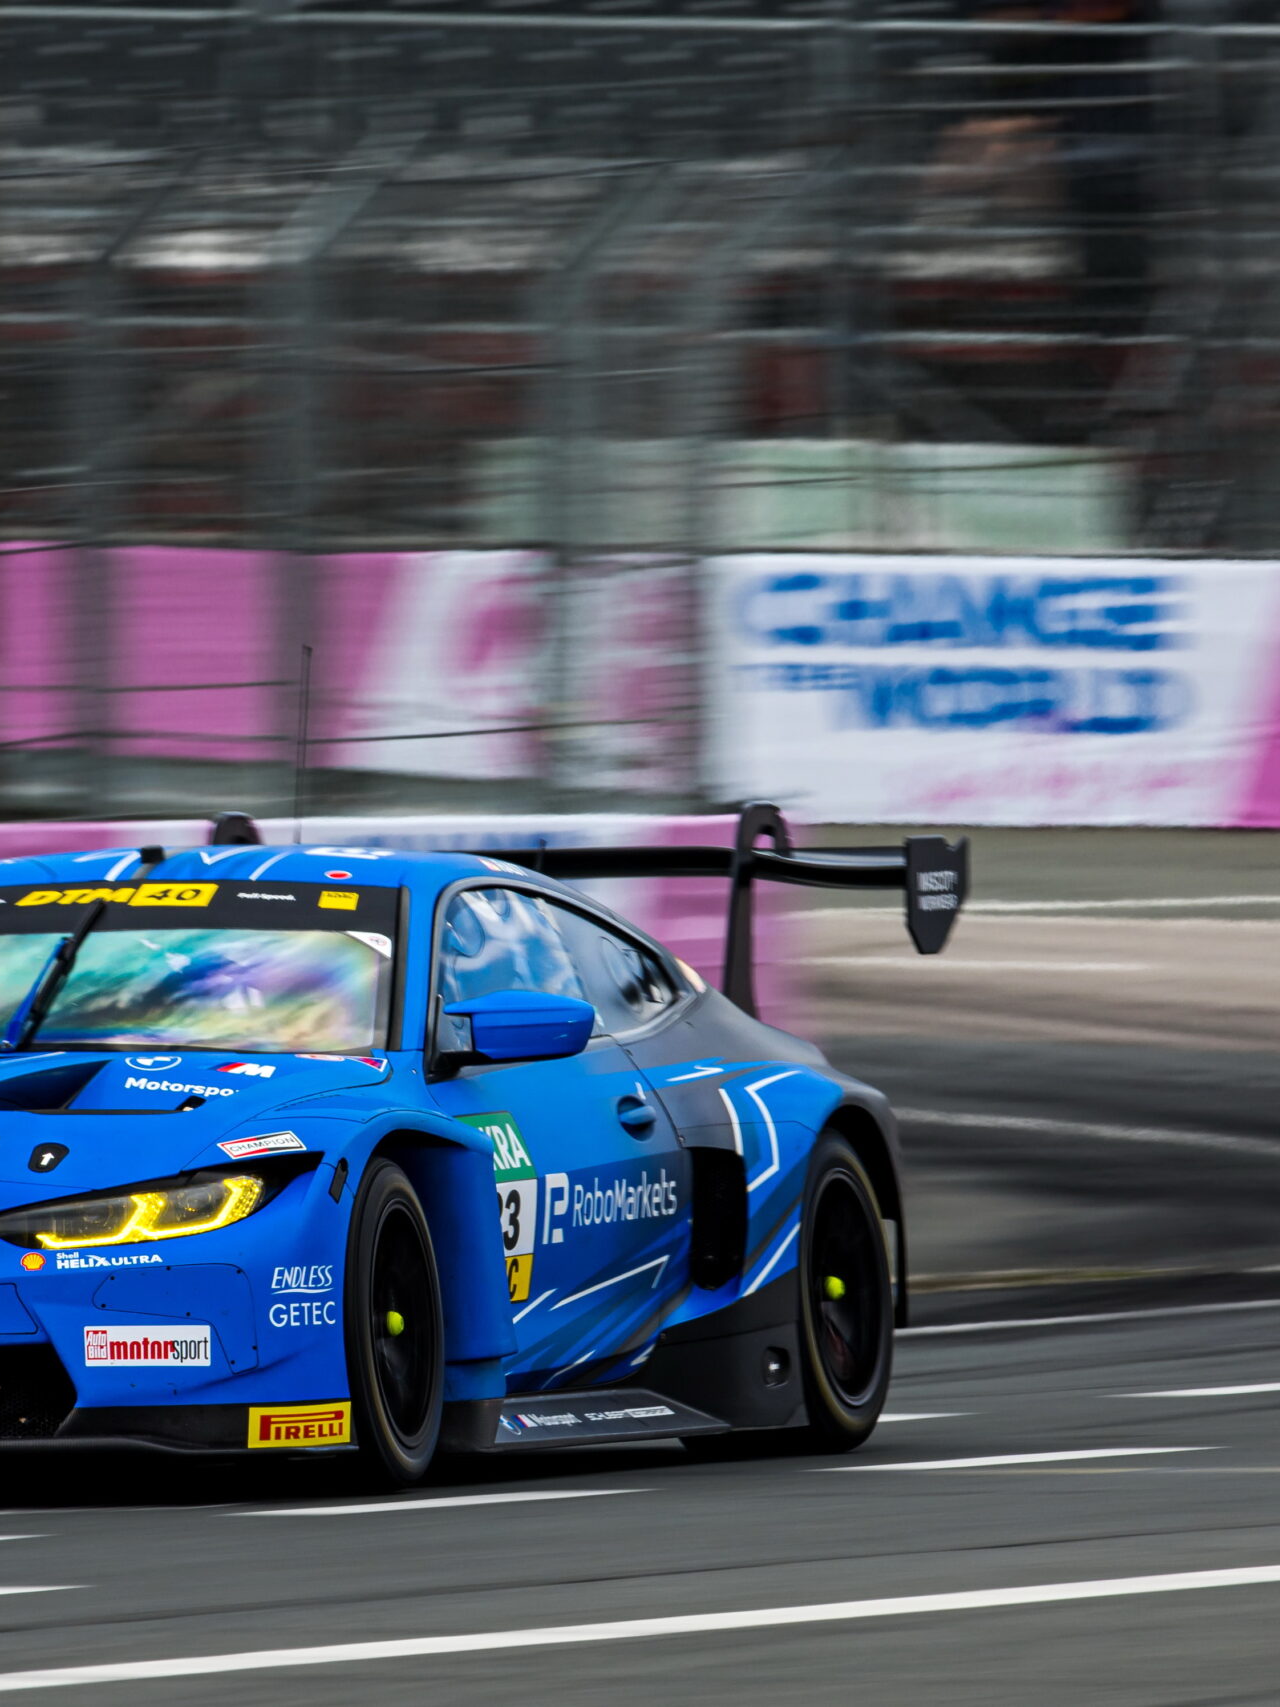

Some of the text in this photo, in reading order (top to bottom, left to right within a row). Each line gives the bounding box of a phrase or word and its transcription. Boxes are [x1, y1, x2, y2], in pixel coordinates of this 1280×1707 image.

[14, 887, 136, 906] DTM
[148, 888, 202, 901] 40
[124, 1077, 239, 1097] Motorspo
[229, 1136, 295, 1152] CHAMPION
[572, 1169, 678, 1228] RoboMarkets
[56, 1252, 79, 1260] Shell
[56, 1253, 163, 1269] HELIX ULTRA
[270, 1264, 333, 1290] ENDLESS
[268, 1301, 336, 1328] GETEC
[87, 1331, 107, 1346] Auto
[88, 1345, 107, 1359] Bild
[259, 1409, 345, 1441] PIRELLI
